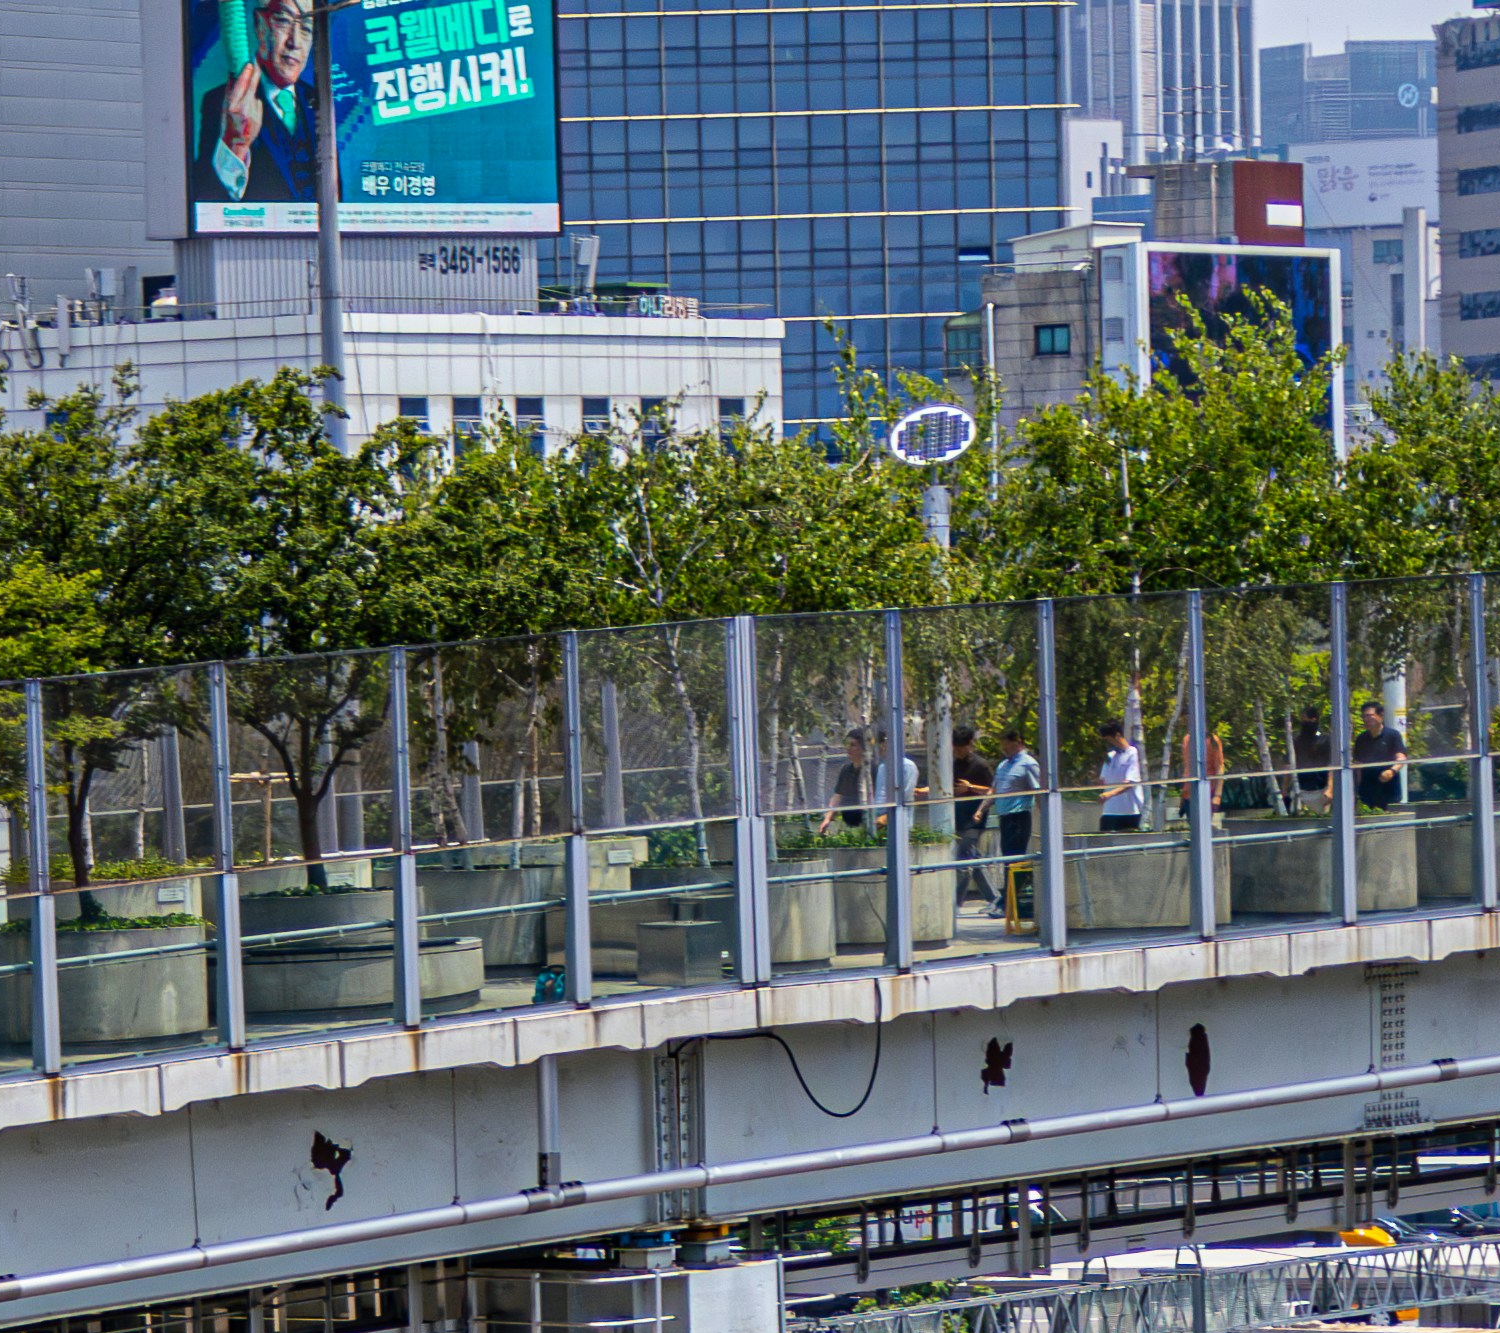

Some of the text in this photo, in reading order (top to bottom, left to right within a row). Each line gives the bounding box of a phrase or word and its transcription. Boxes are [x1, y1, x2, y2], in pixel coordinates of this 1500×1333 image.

[364, 0, 535, 66] 코웰메디로
[372, 46, 529, 119] 진행시켜!
[362, 175, 436, 196] 배우 이경영
[439, 246, 522, 275] 3461-1566
